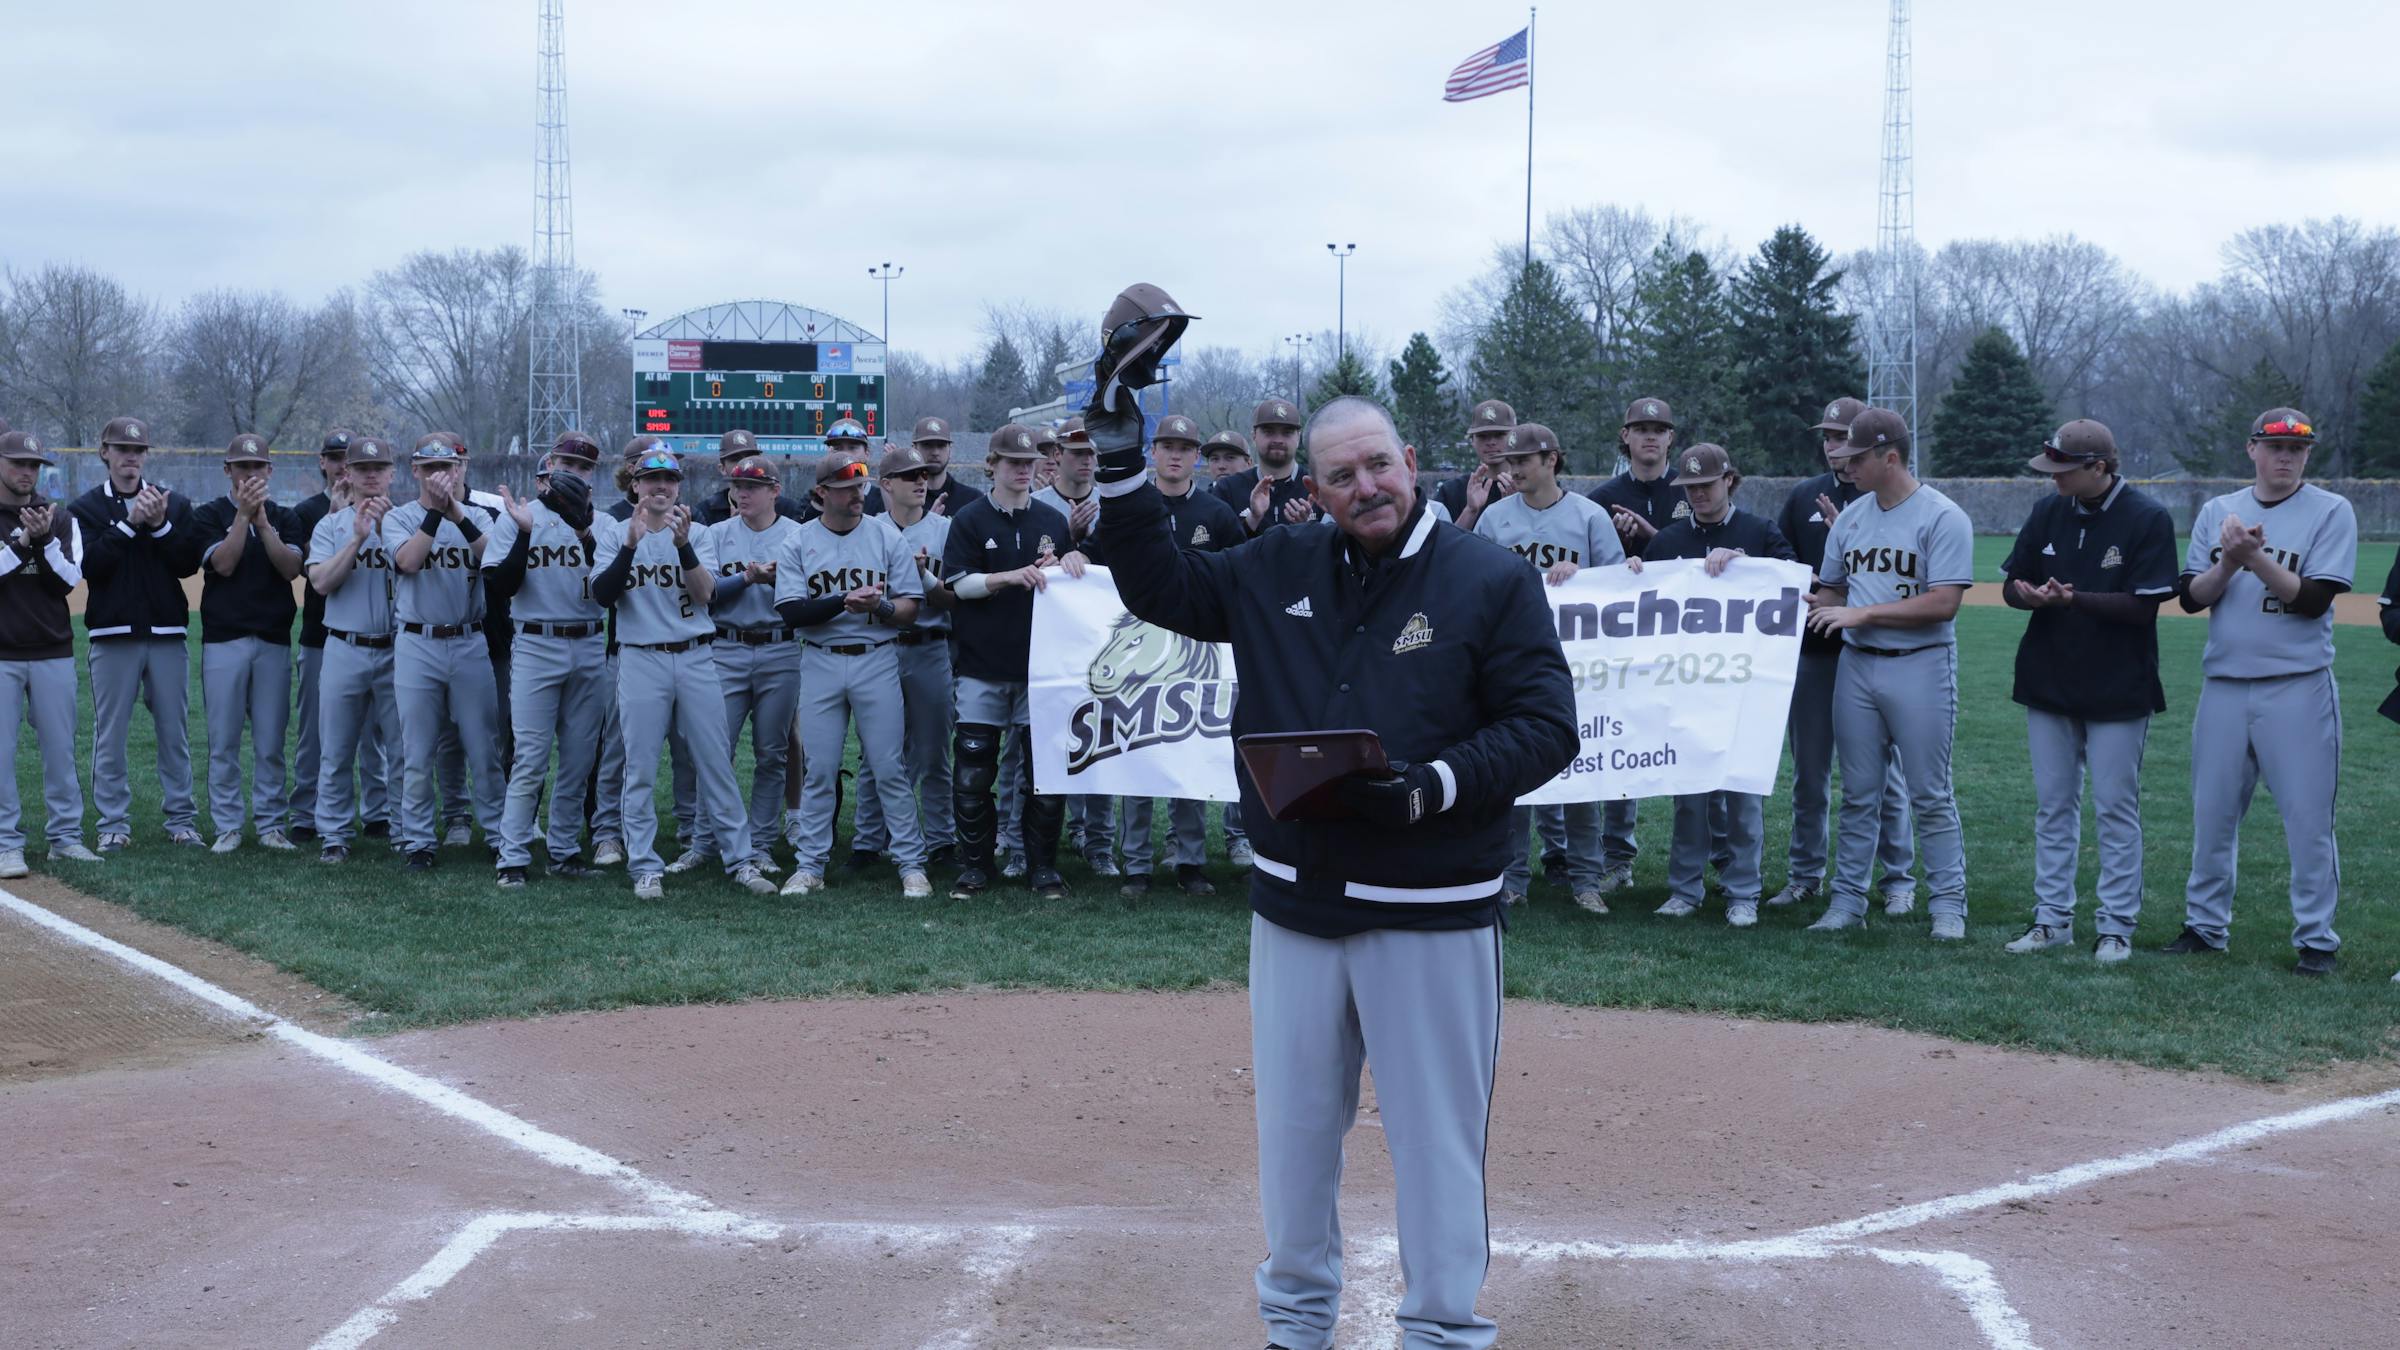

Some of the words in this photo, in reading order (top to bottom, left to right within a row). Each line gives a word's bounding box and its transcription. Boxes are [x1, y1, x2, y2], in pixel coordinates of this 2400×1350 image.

[645, 373, 655, 381] AT
[657, 373, 672, 381] BAT
[705, 373, 726, 382] BALL
[755, 374, 783, 383] STRIKE
[810, 375, 827, 384] OUT
[860, 375, 874, 384] H/E
[712, 382, 721, 397] 0
[764, 382, 774, 398] 0
[814, 383, 824, 399] 0
[863, 403, 877, 411] ERR
[815, 410, 823, 421] 0
[867, 410, 875, 422] 0
[646, 422, 671, 431] SMSU
[815, 423, 823, 435] 0
[867, 423, 875, 435] 0
[351, 547, 391, 570] MS
[420, 547, 480, 569] MSU
[1507, 542, 1579, 568] MSU
[1844, 548, 1917, 578] SMSU
[1285, 607, 1313, 618] adidas
[1550, 587, 1800, 641] nchard
[1393, 628, 1433, 651] SMSU
[1568, 653, 1754, 693] 997-2023
[1066, 681, 1240, 770] SMSU
[1580, 715, 1624, 740] all's
[1610, 742, 1678, 771] Coach
